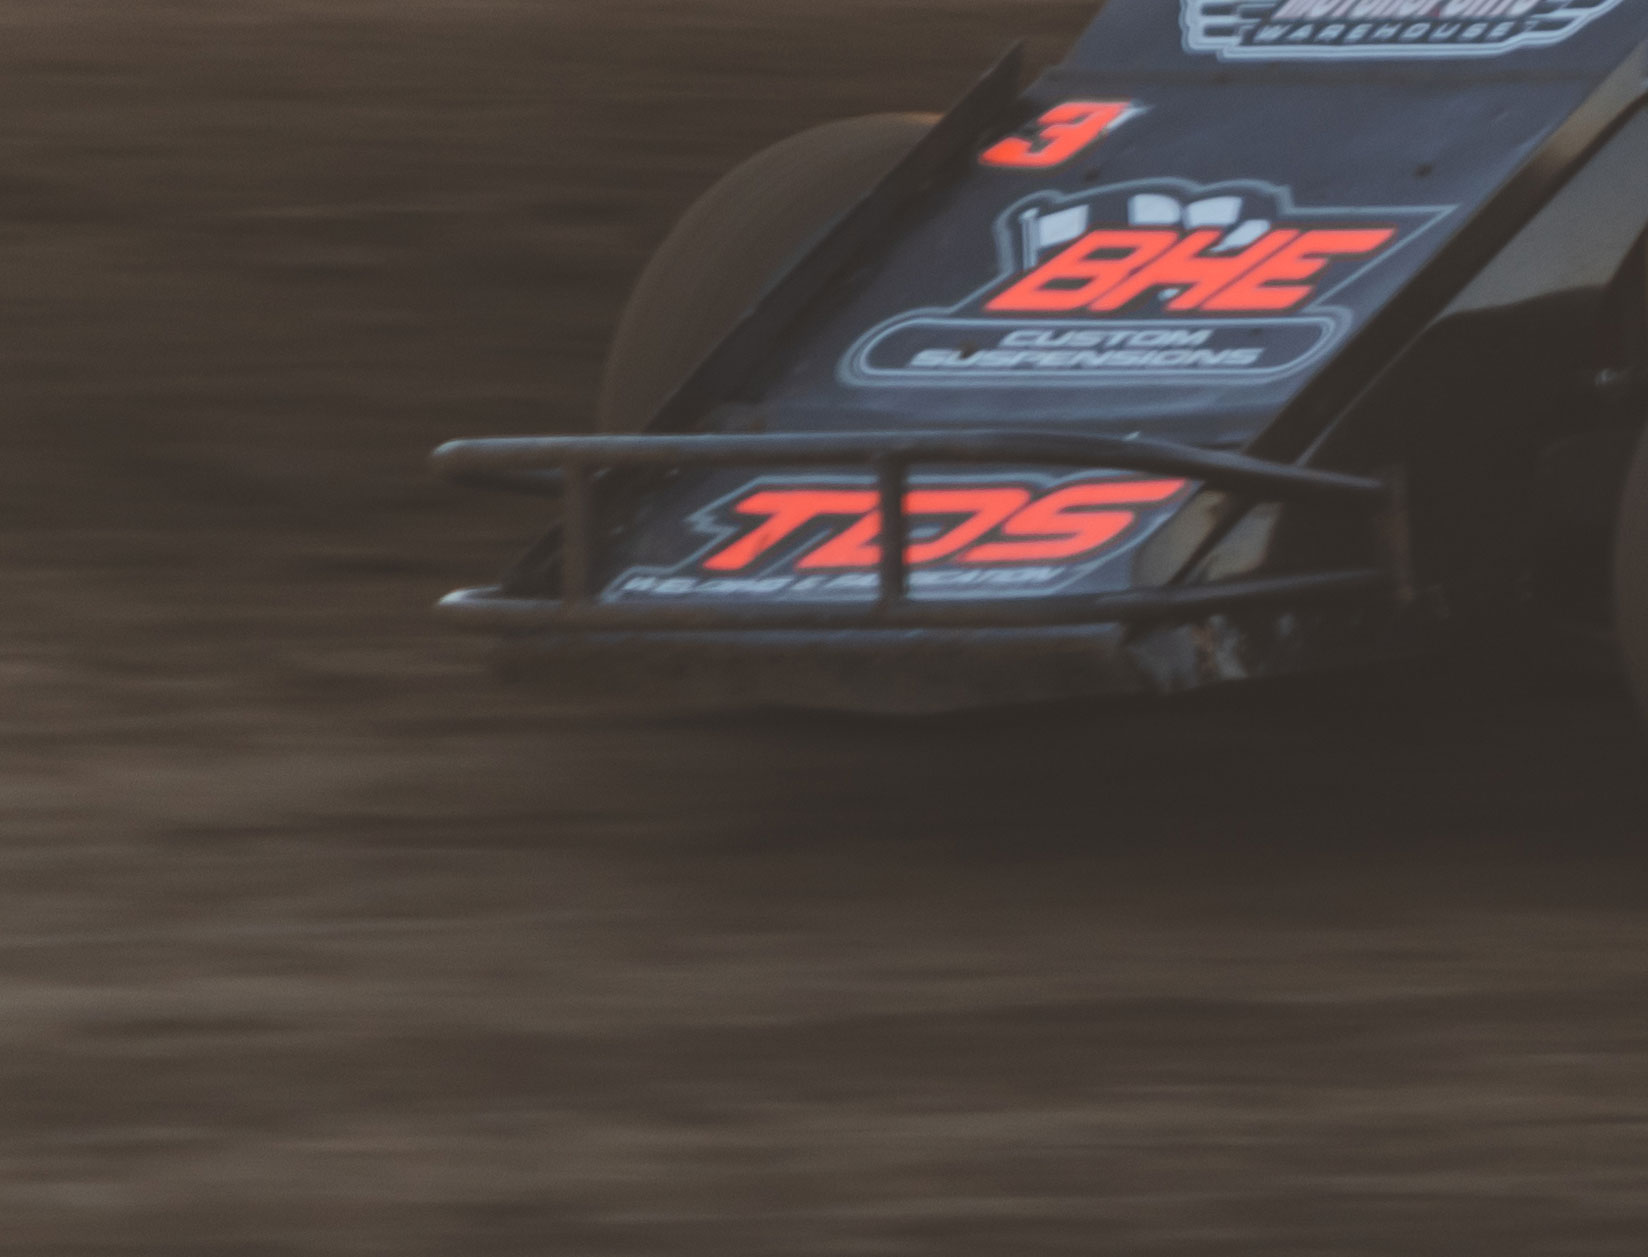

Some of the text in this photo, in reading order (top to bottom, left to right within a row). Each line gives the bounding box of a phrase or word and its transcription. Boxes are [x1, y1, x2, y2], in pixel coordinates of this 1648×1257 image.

[1252, 22, 1516, 42] WAREHOUSE
[983, 228, 1396, 313] BHE
[998, 329, 1214, 347] CUSTOM
[909, 347, 1265, 369] SUSPENSIONS
[703, 479, 1186, 570] TDS
